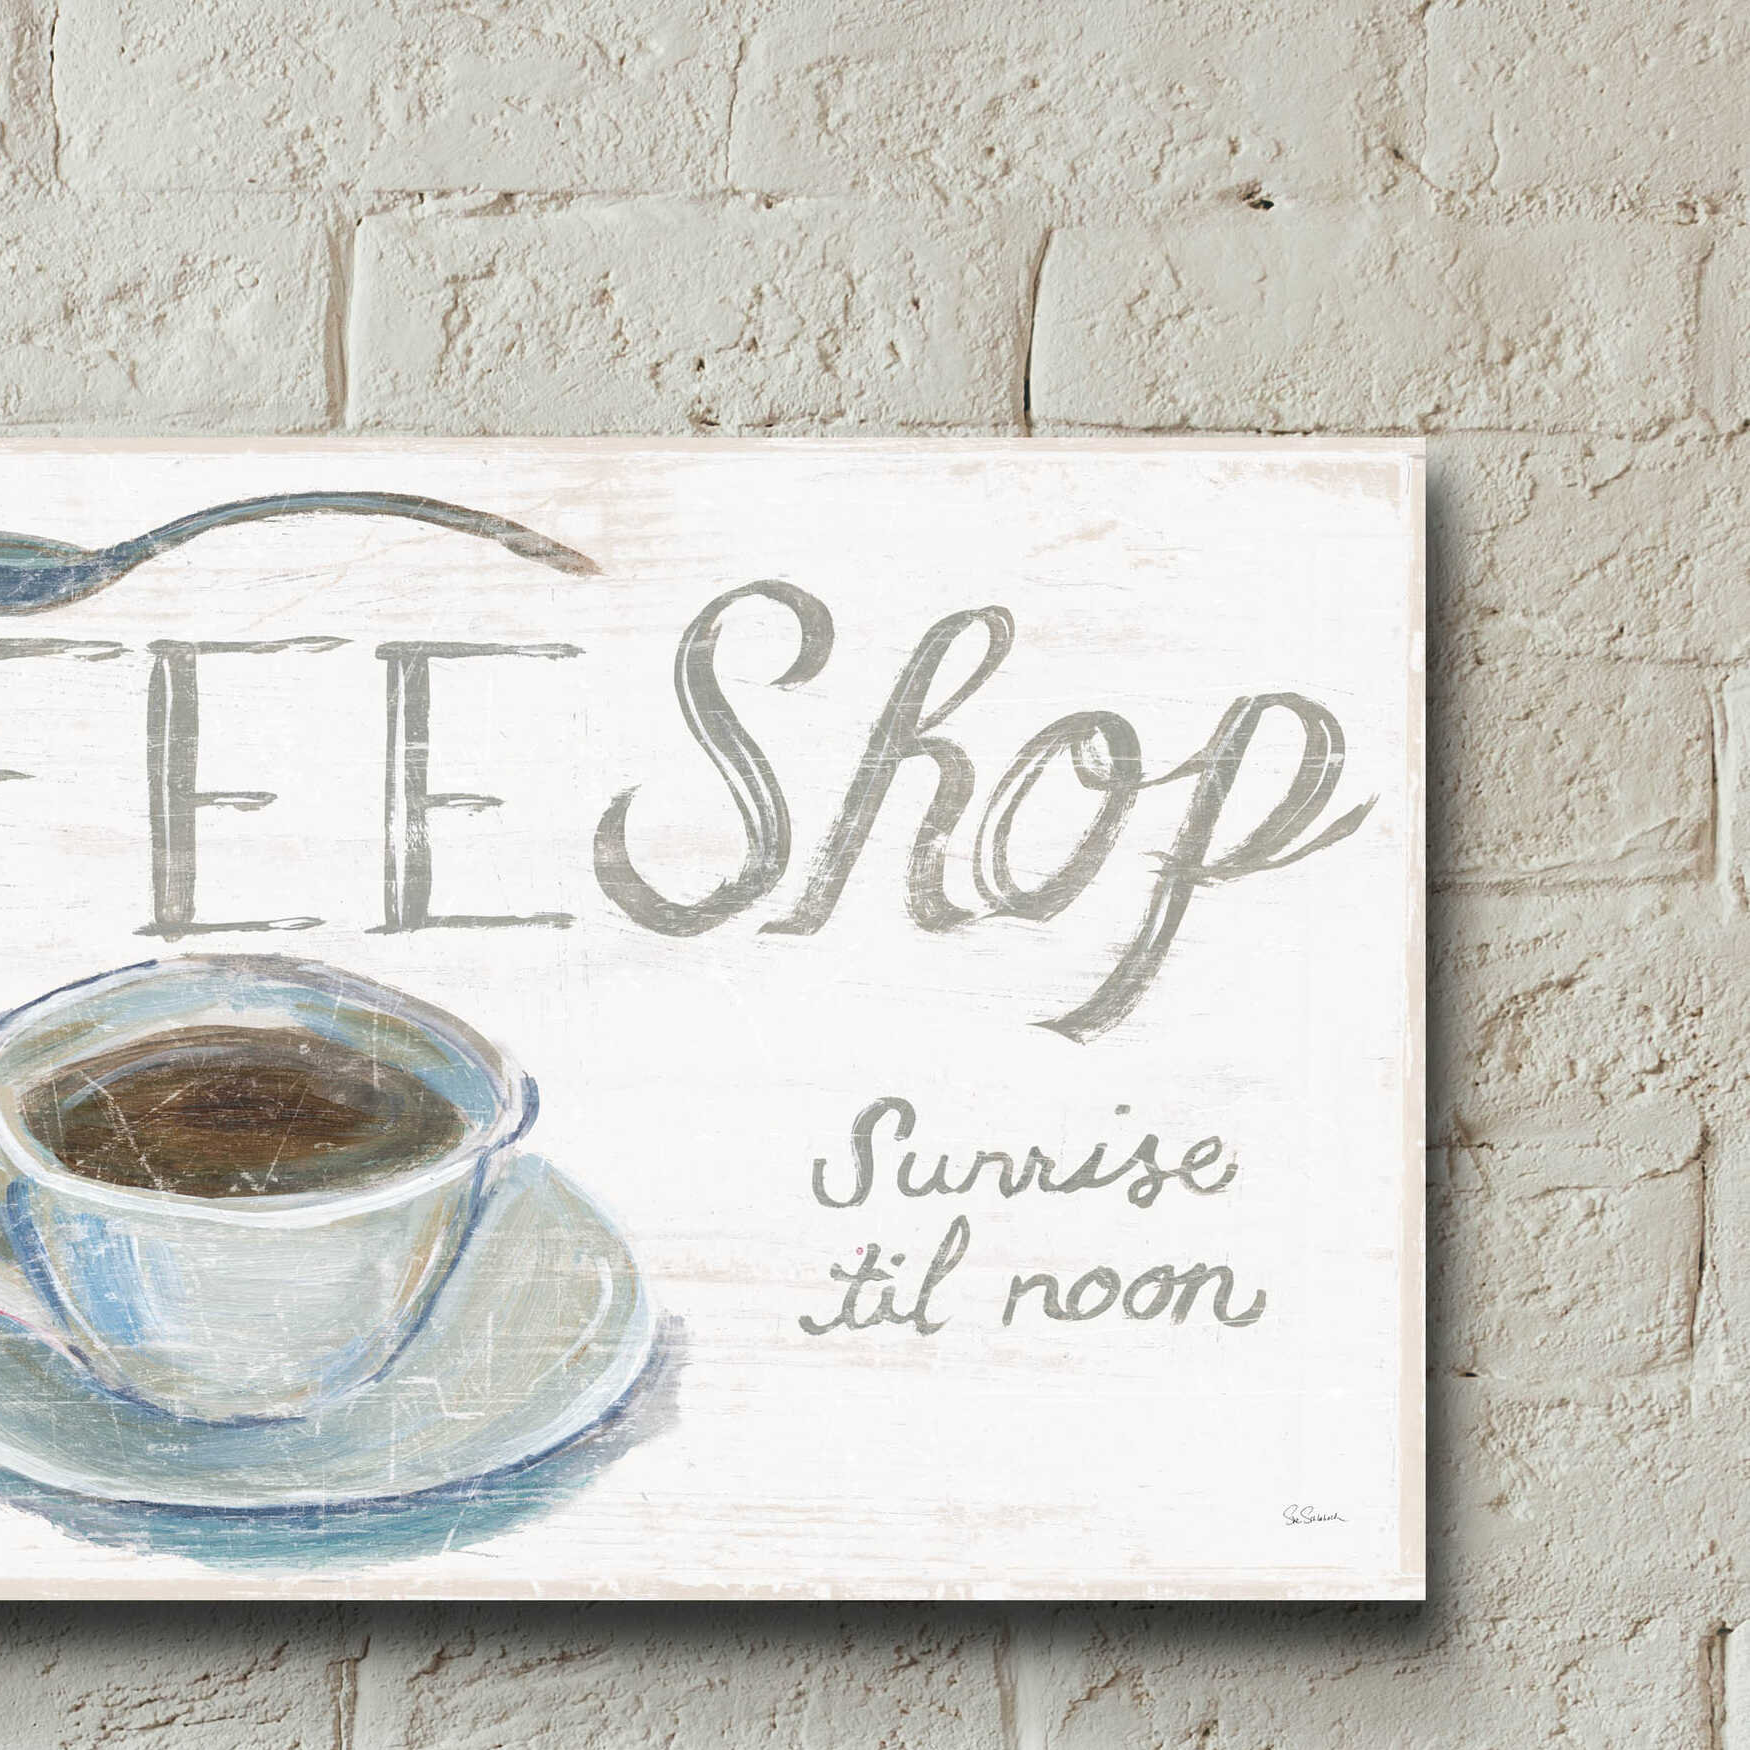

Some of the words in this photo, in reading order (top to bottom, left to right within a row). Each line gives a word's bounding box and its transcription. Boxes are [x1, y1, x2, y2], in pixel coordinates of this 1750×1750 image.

[593, 579, 1380, 1045] Shop
[812, 1096, 1239, 1209] Sunrise
[1002, 1262, 1267, 1328] noon
